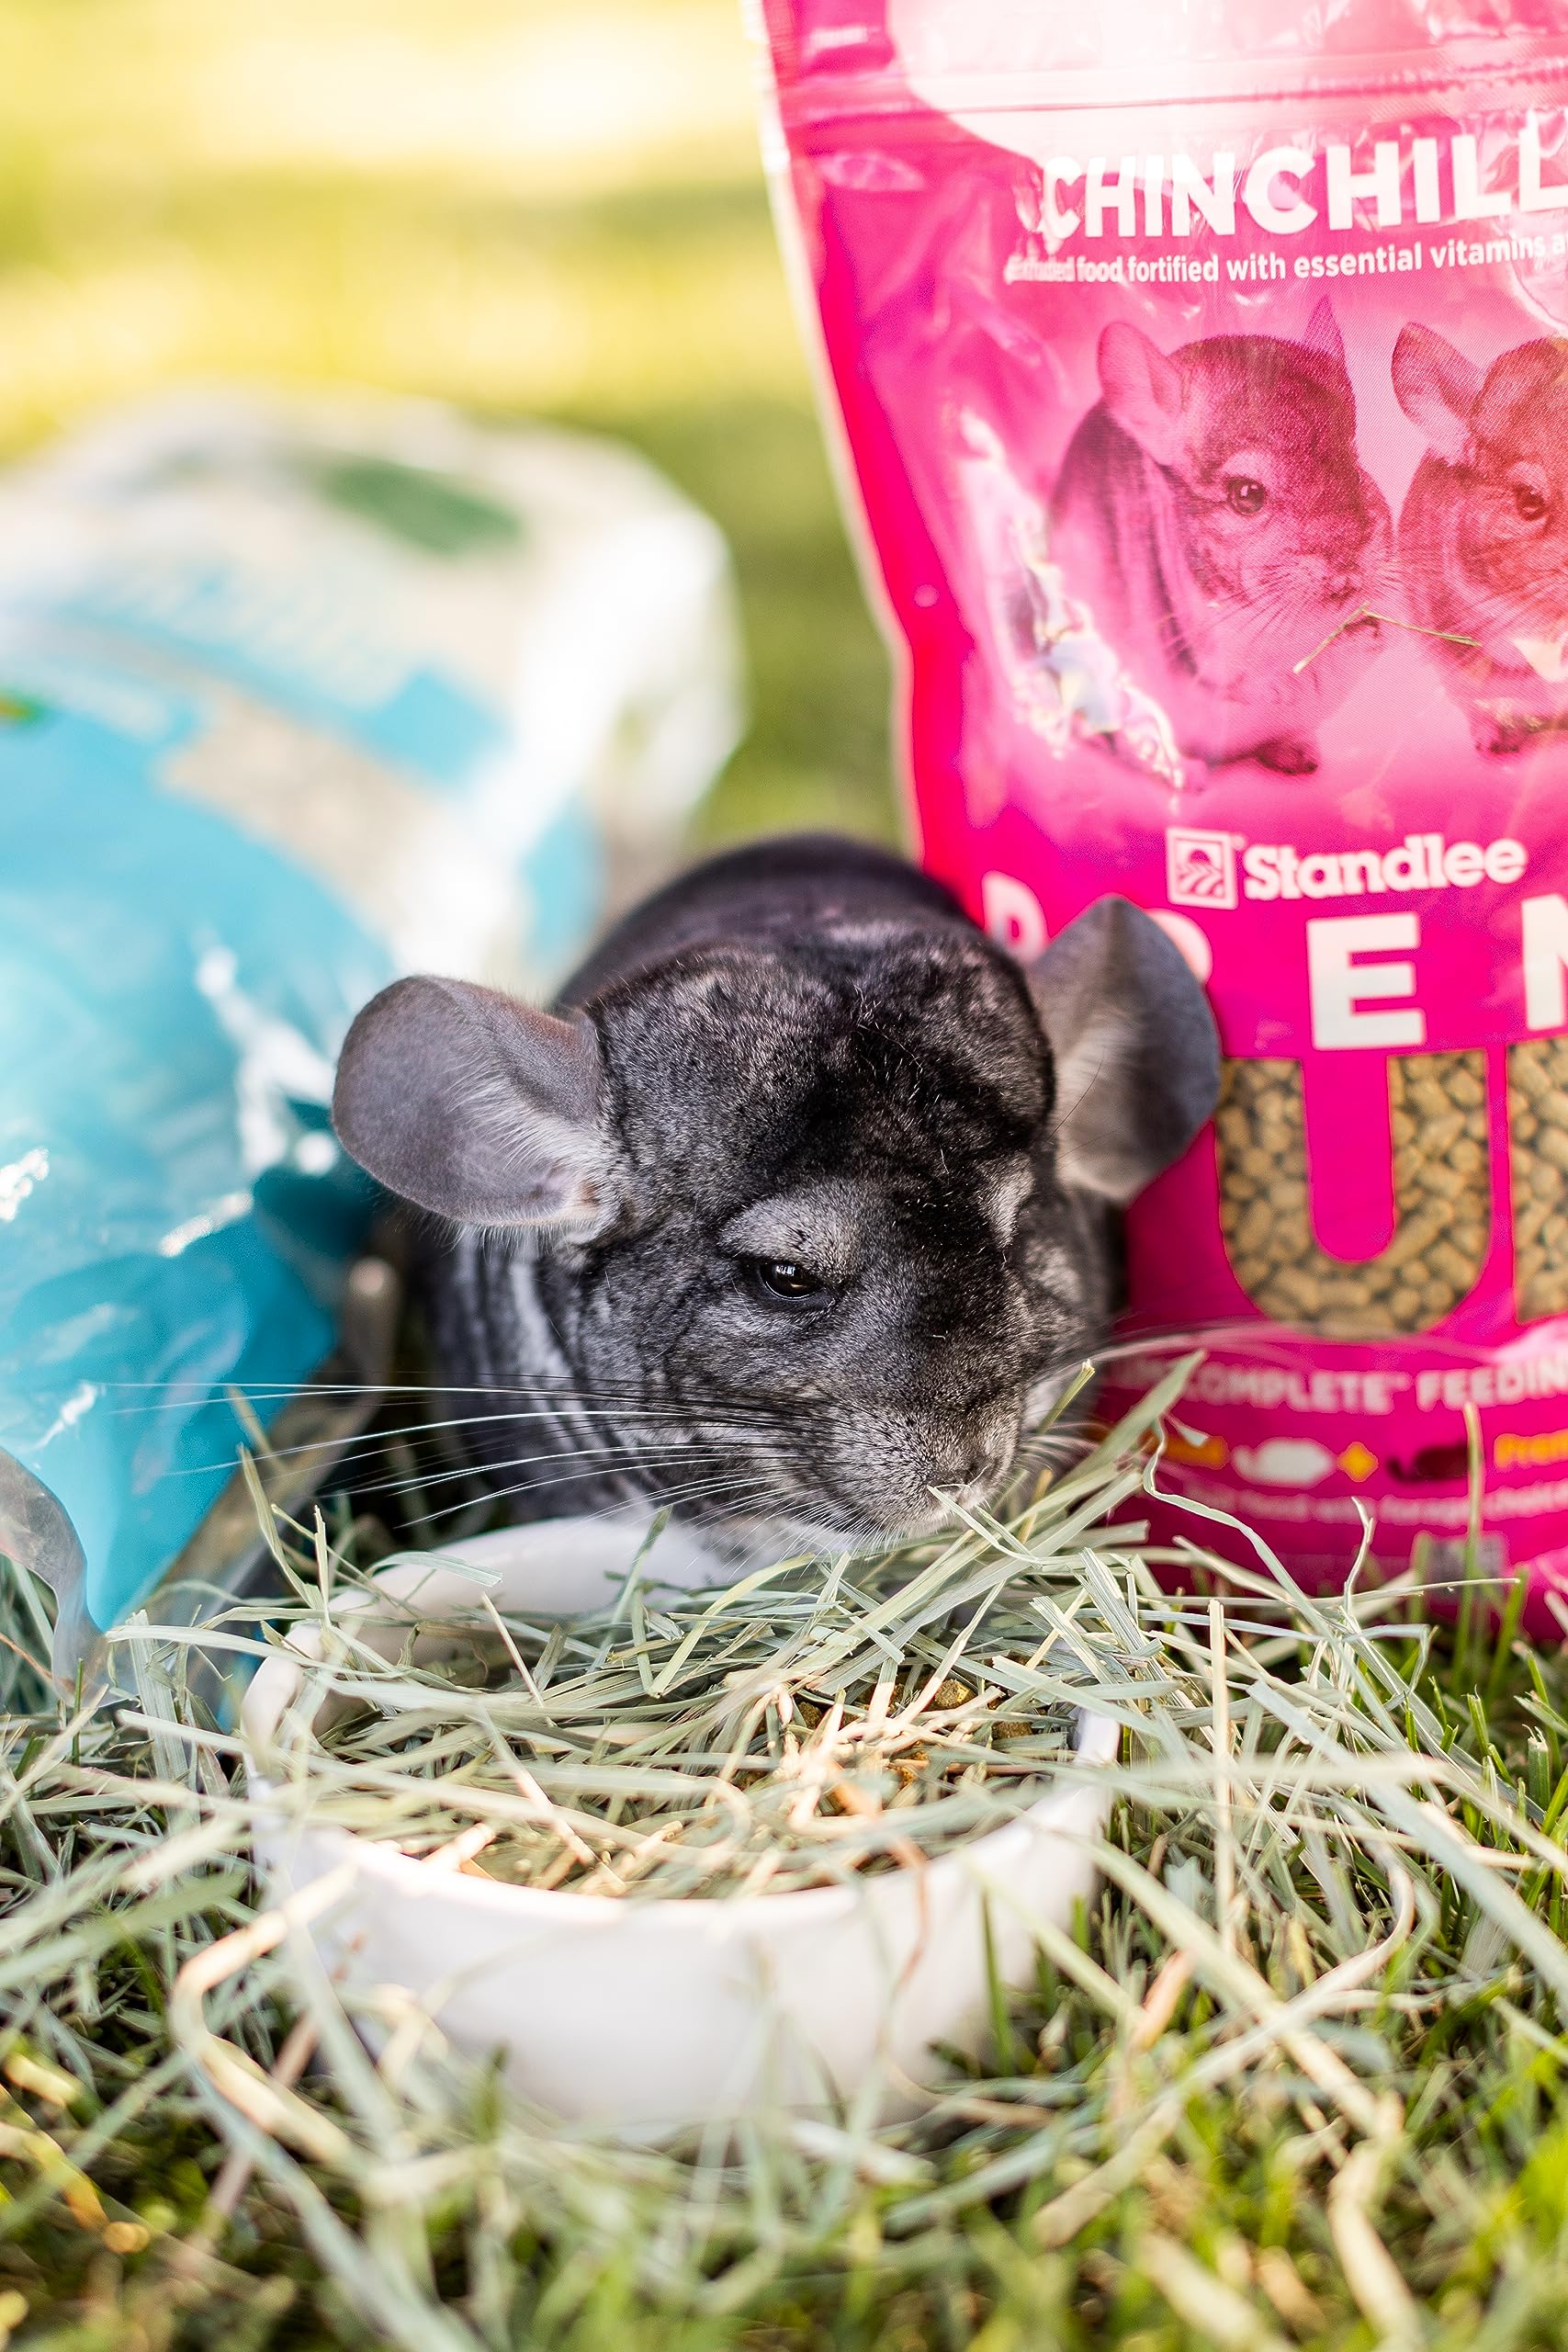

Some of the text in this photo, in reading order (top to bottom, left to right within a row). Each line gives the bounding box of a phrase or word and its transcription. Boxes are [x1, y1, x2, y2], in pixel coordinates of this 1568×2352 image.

[1043, 128, 1568, 239] CHINCHILL
[1077, 256, 1122, 282] food
[1128, 254, 1219, 282] fortified
[1226, 252, 1286, 281] with
[1293, 241, 1422, 278] essential
[1429, 232, 1545, 269] vitamins
[1243, 833, 1529, 901] Standlee
[1179, 1362, 1394, 1415] OMPLETE
